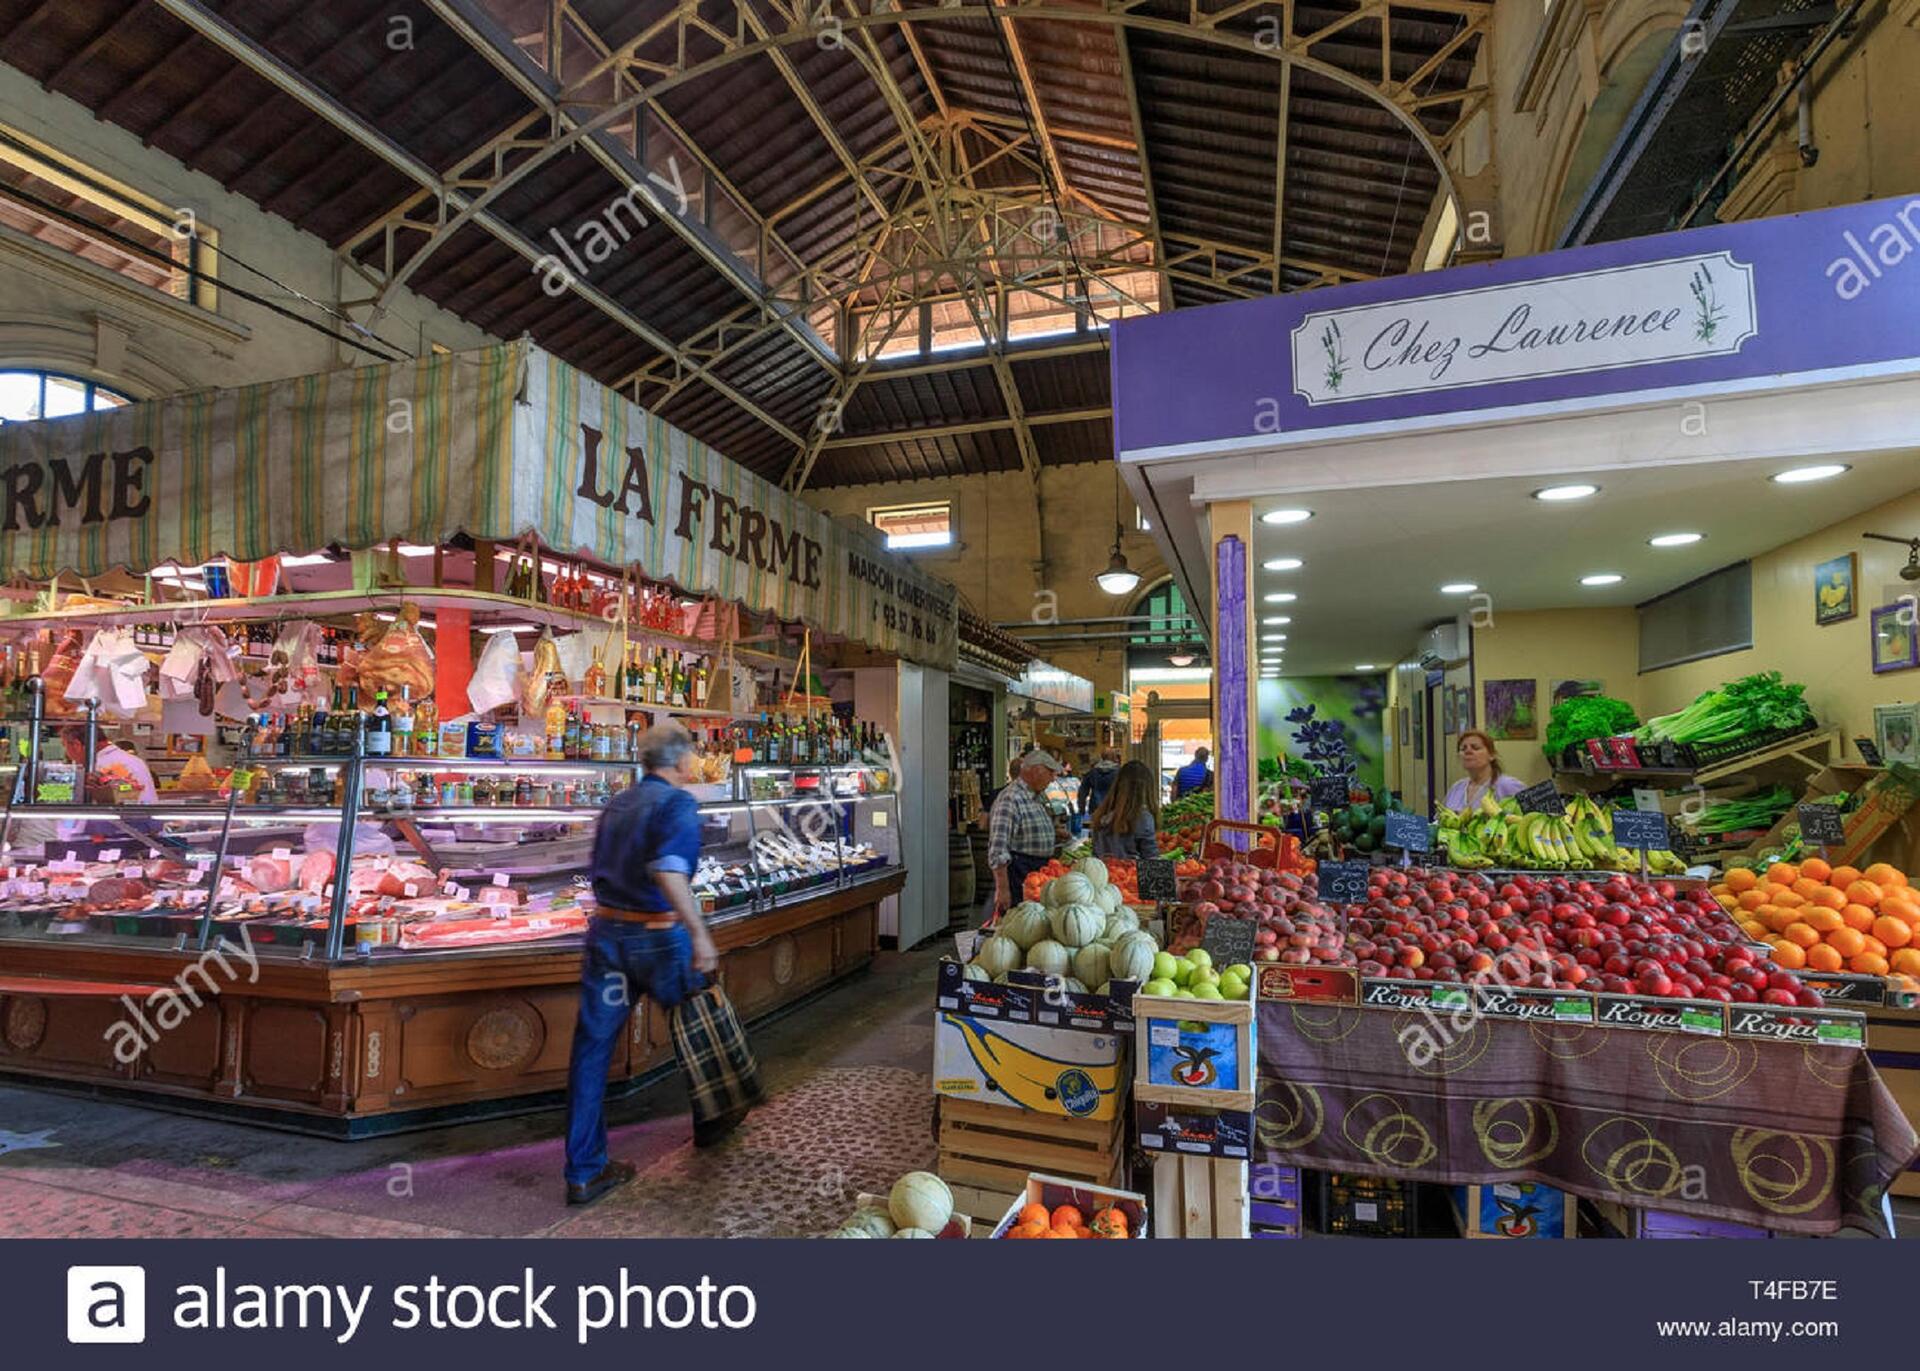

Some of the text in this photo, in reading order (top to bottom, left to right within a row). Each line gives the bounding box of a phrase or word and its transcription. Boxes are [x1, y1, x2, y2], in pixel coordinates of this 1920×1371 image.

[1362, 303, 1681, 380] Chez Laurence
[0, 446, 154, 532] RME
[577, 423, 823, 592] LA FERME
[848, 551, 894, 596] MAISON
[1364, 985, 1432, 1008] Roya
